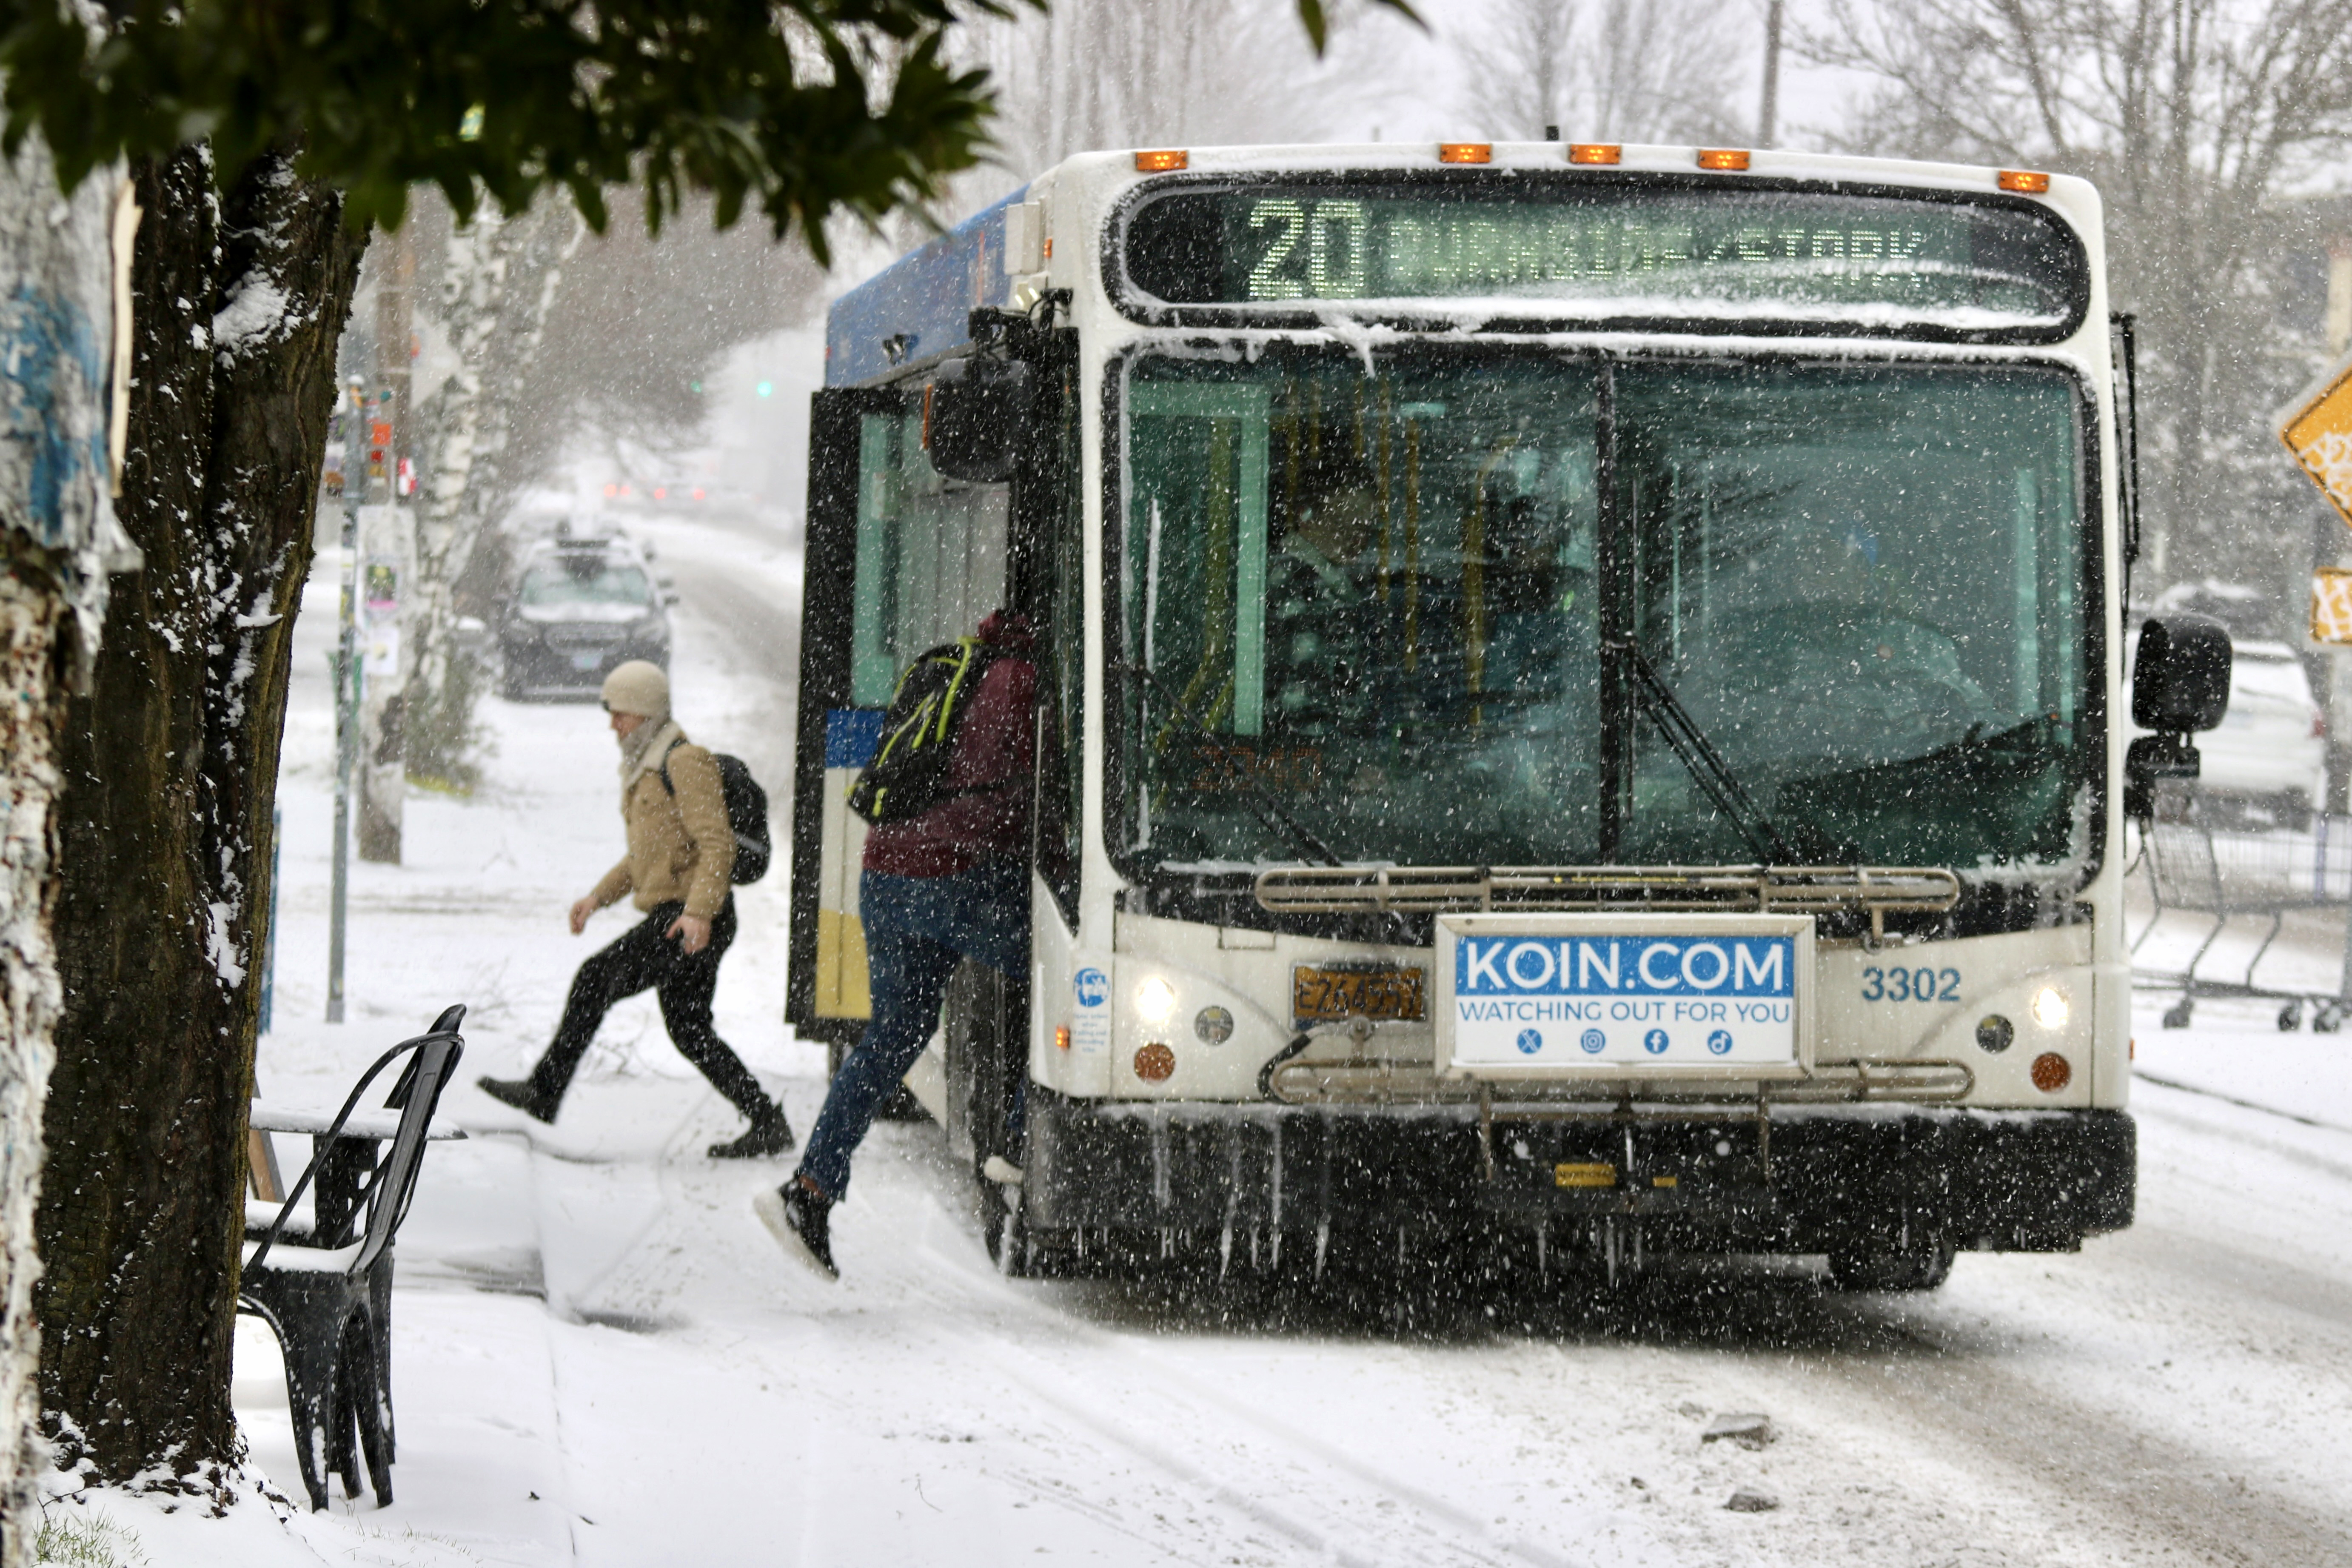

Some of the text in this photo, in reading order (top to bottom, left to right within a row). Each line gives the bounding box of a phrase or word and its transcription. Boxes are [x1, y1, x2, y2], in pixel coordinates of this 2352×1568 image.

[1249, 199, 1365, 298] 20
[1467, 941, 1783, 991] KOIN.COM
[1862, 966, 1961, 1002] 3302
[1459, 1001, 1790, 1023] WATCHING OUT FOR YOU
